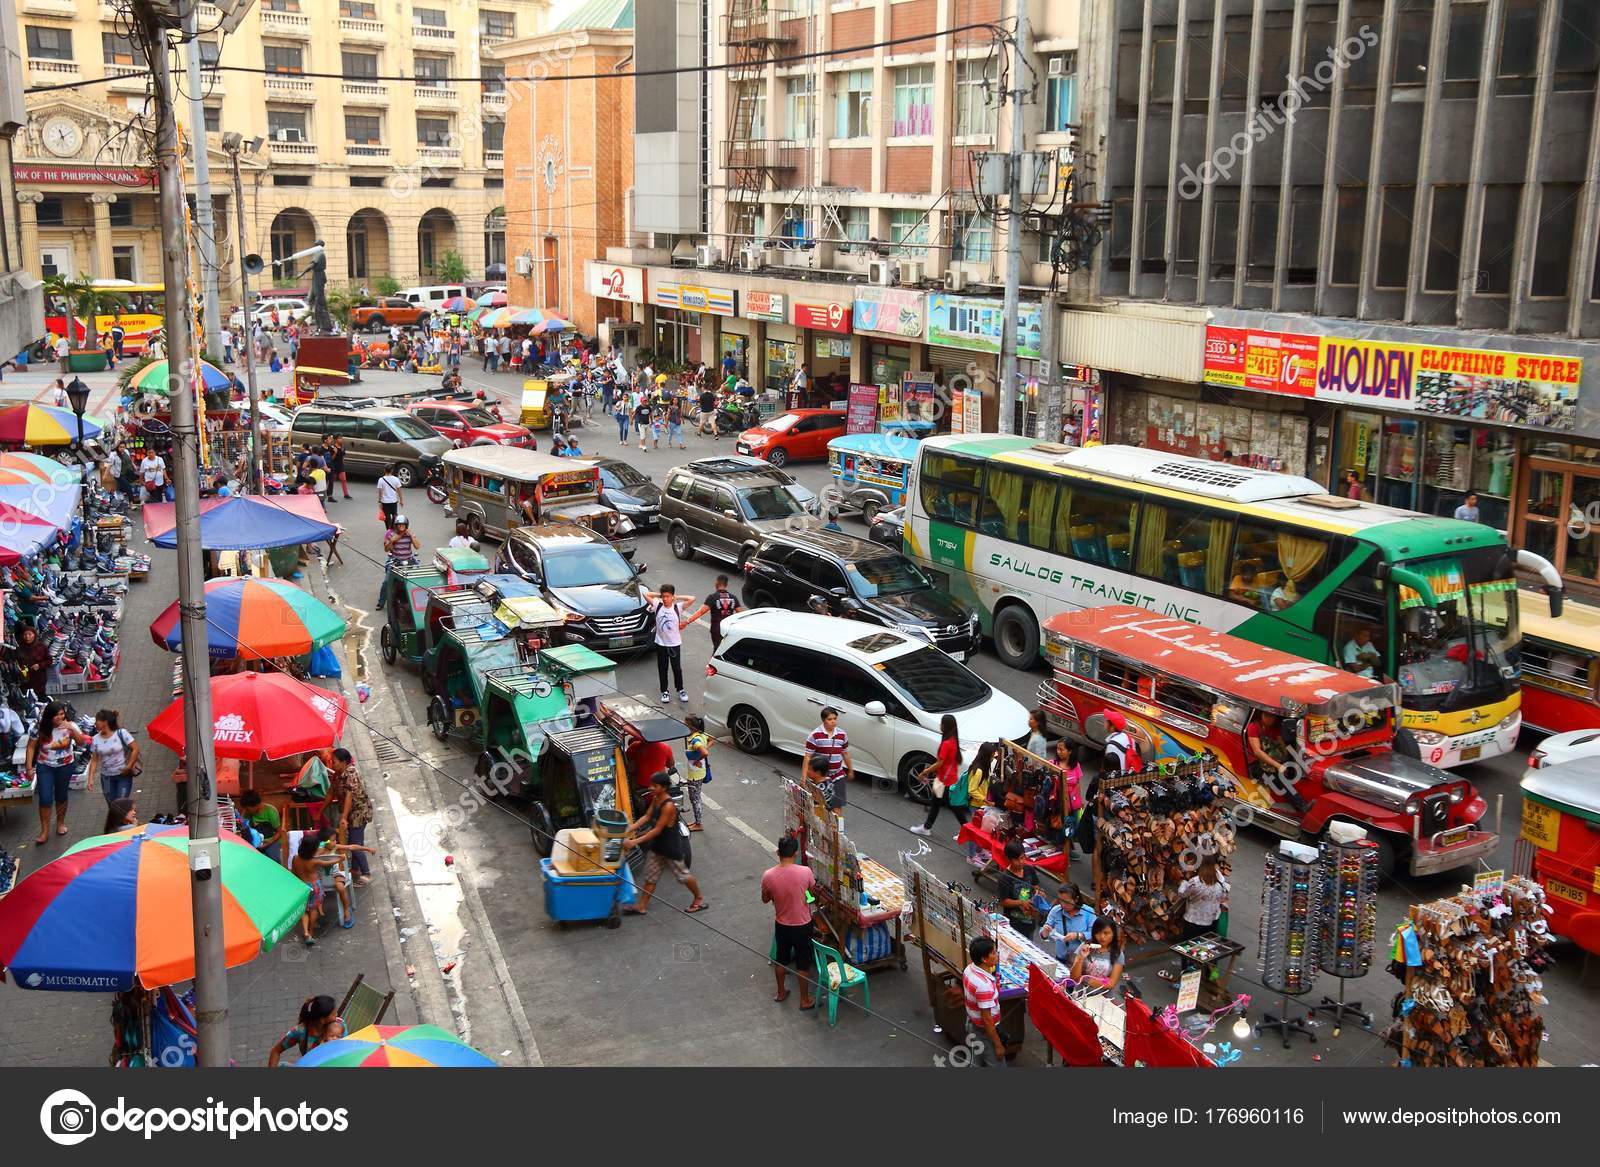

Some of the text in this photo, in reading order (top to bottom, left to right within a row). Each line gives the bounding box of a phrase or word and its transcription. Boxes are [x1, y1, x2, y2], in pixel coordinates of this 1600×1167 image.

[31, 171, 42, 180] OF
[43, 172, 58, 181] THE
[60, 172, 104, 182] PHILIPPINE
[106, 173, 140, 182] ISLANDS
[1205, 370, 1234, 381] Avenida
[1318, 344, 1414, 400] JHOLDEN
[1420, 348, 1580, 384] CLOTHING STORE
[989, 553, 1064, 584] SAULOG
[1163, 600, 1202, 625] INC.
[45, 975, 119, 988] MICROMATIC
